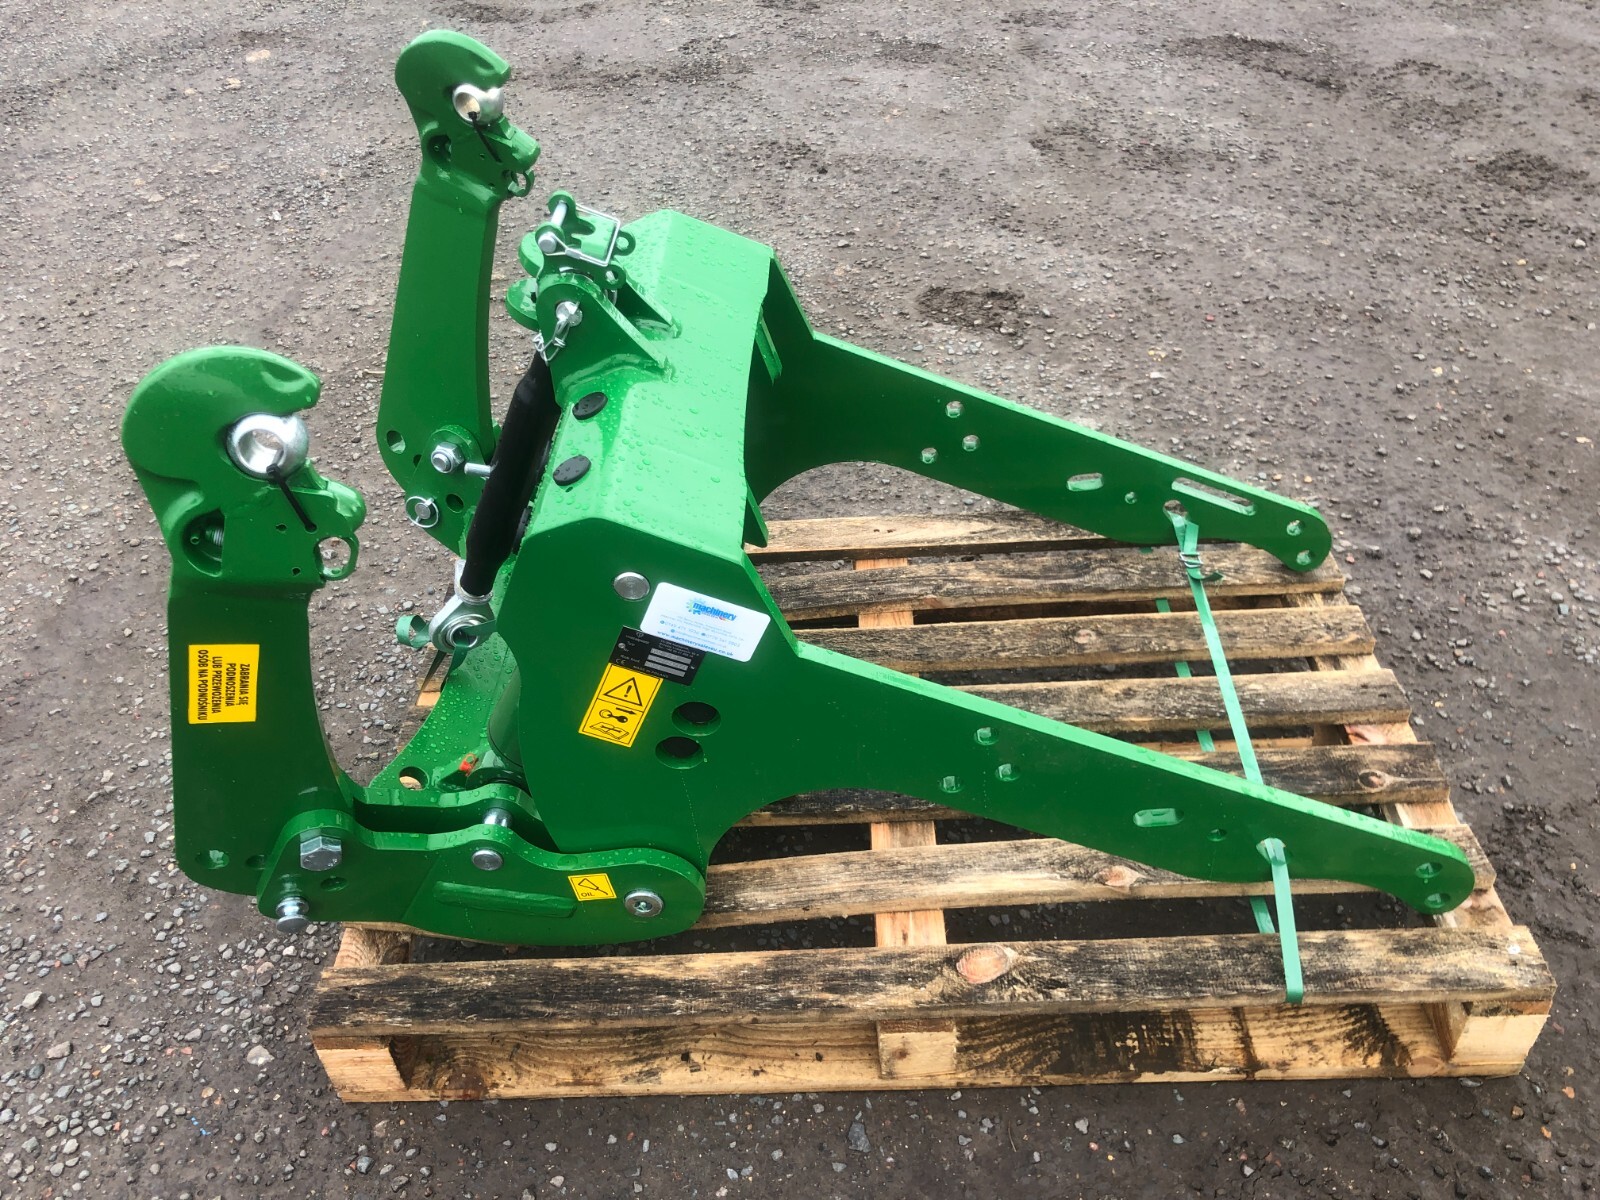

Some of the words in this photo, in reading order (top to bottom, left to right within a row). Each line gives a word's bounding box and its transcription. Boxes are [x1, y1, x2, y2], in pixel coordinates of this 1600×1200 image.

[693, 602, 737, 621] machinery
[197, 649, 211, 668] OSÓB
[212, 656, 223, 669] LUB
[198, 669, 209, 679] NA
[239, 663, 251, 695] ZABRANIA
[212, 670, 224, 714] PRZEWOŻENIA
[225, 663, 236, 707] PODNOSZENIA
[197, 679, 210, 721] PODNOŚNIKU
[236, 696, 249, 706] SIĘ
